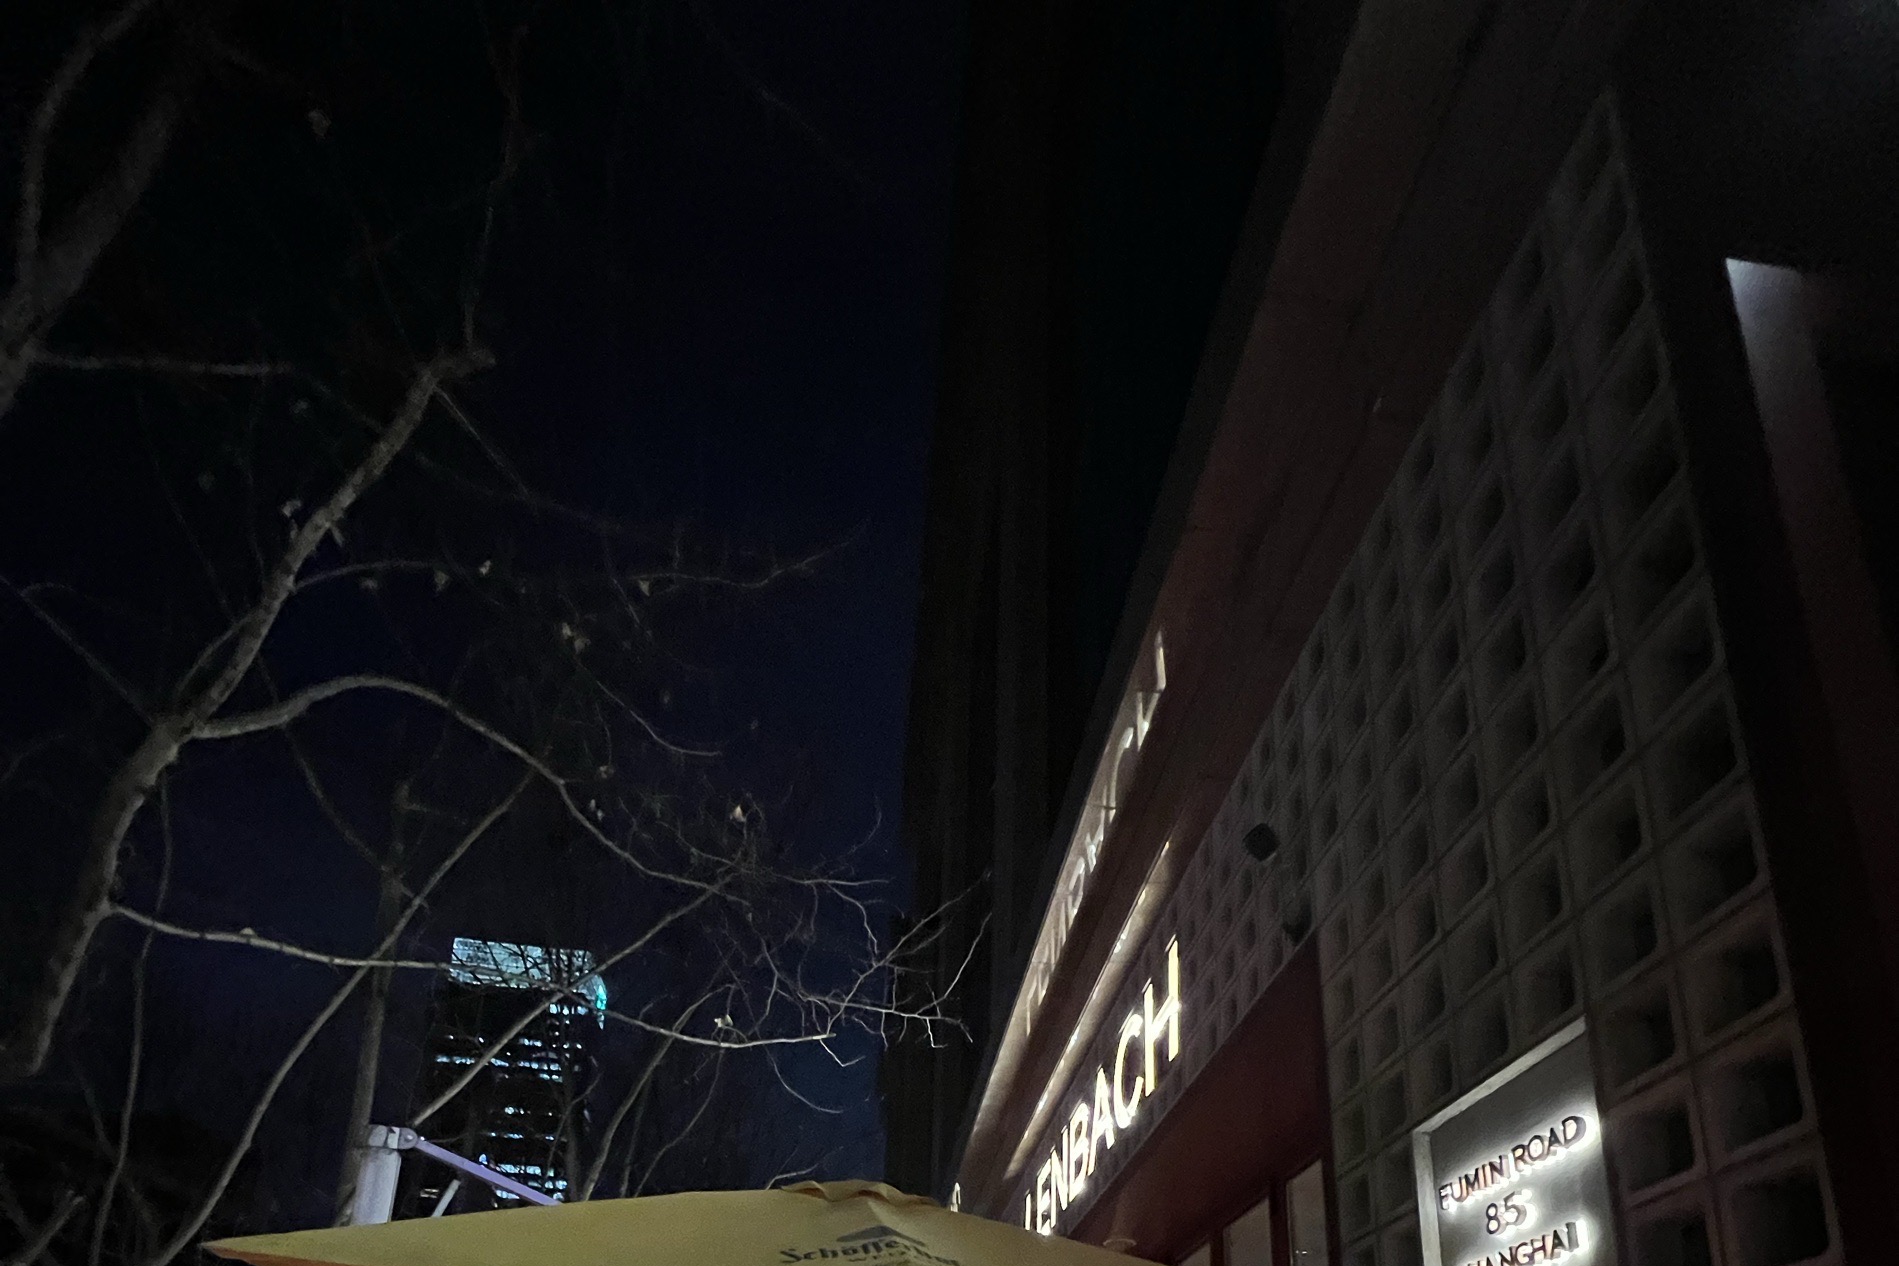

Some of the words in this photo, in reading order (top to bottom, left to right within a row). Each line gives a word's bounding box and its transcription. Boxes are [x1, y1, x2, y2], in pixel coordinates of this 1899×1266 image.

[1437, 1154, 1505, 1211] FUMIN
[1509, 1115, 1587, 1174] ROAD
[1485, 1191, 1528, 1235] 85
